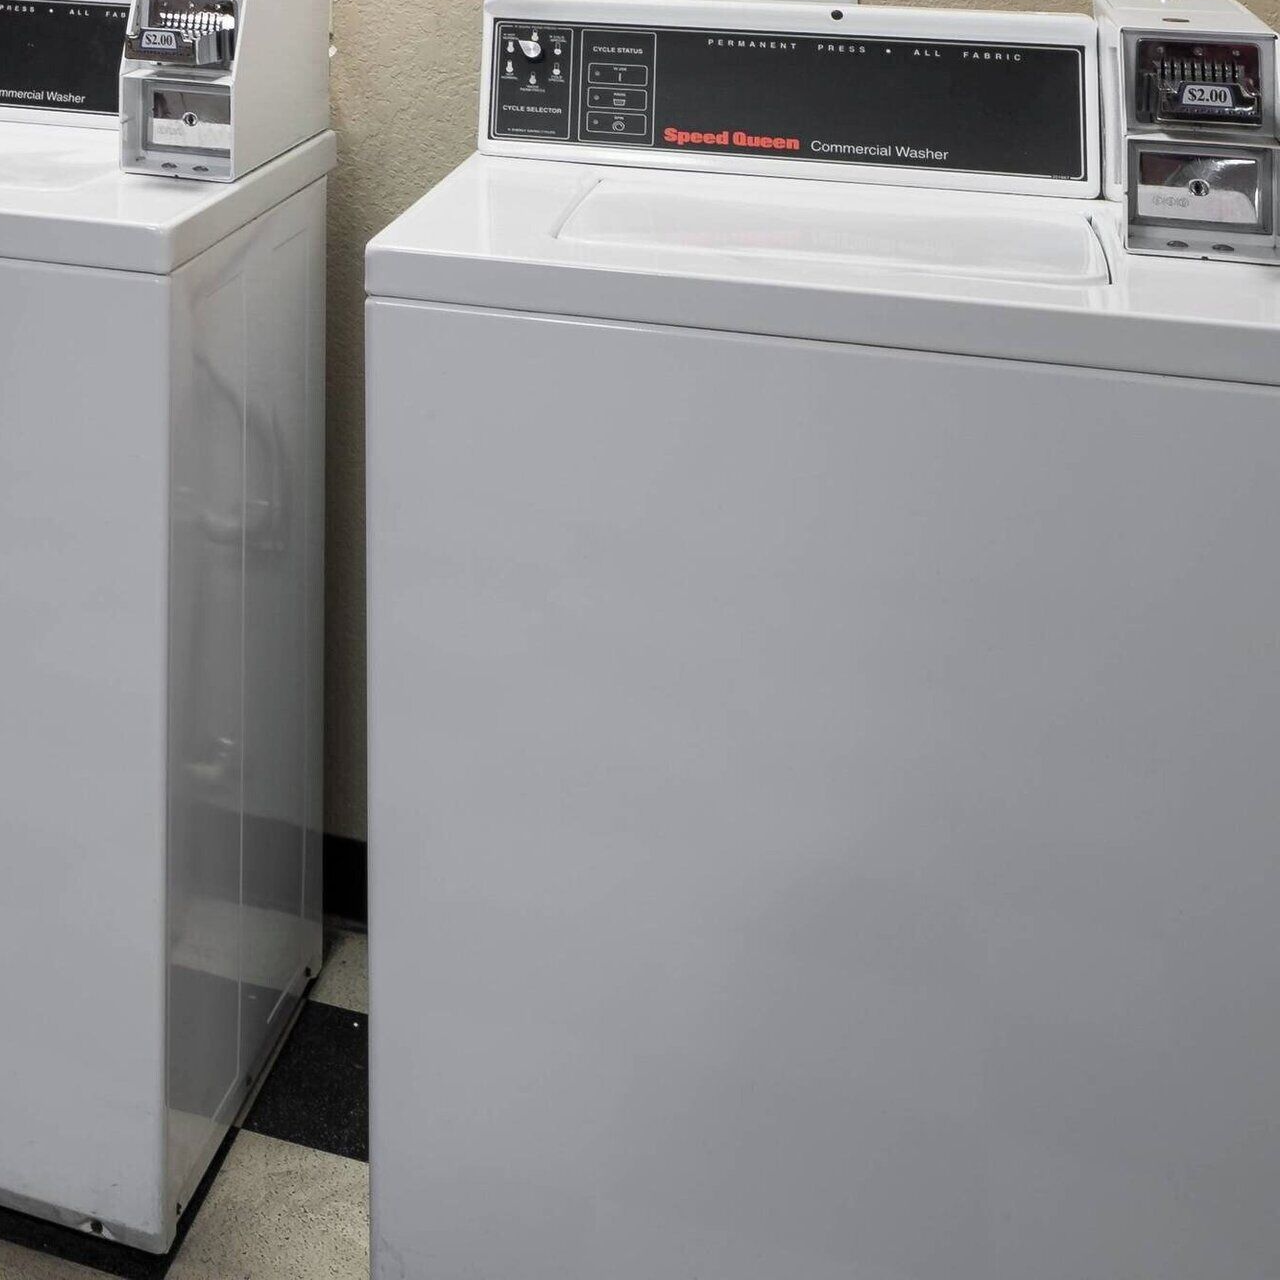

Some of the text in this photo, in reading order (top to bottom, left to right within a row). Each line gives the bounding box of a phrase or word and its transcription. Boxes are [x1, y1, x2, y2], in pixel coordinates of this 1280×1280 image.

[69, 8, 90, 17] ALL
[144, 32, 173, 47] $2.00
[592, 45, 644, 56] CYCLE STATUS
[707, 38, 1022, 62] PERMANENT PRESS ALL FABRIC
[46, 90, 87, 105] Washer
[1187, 87, 1229, 104] $2.00
[502, 104, 563, 115] CYCLE SELECTOR
[664, 127, 950, 161] Speed Queen Commercial Washer
